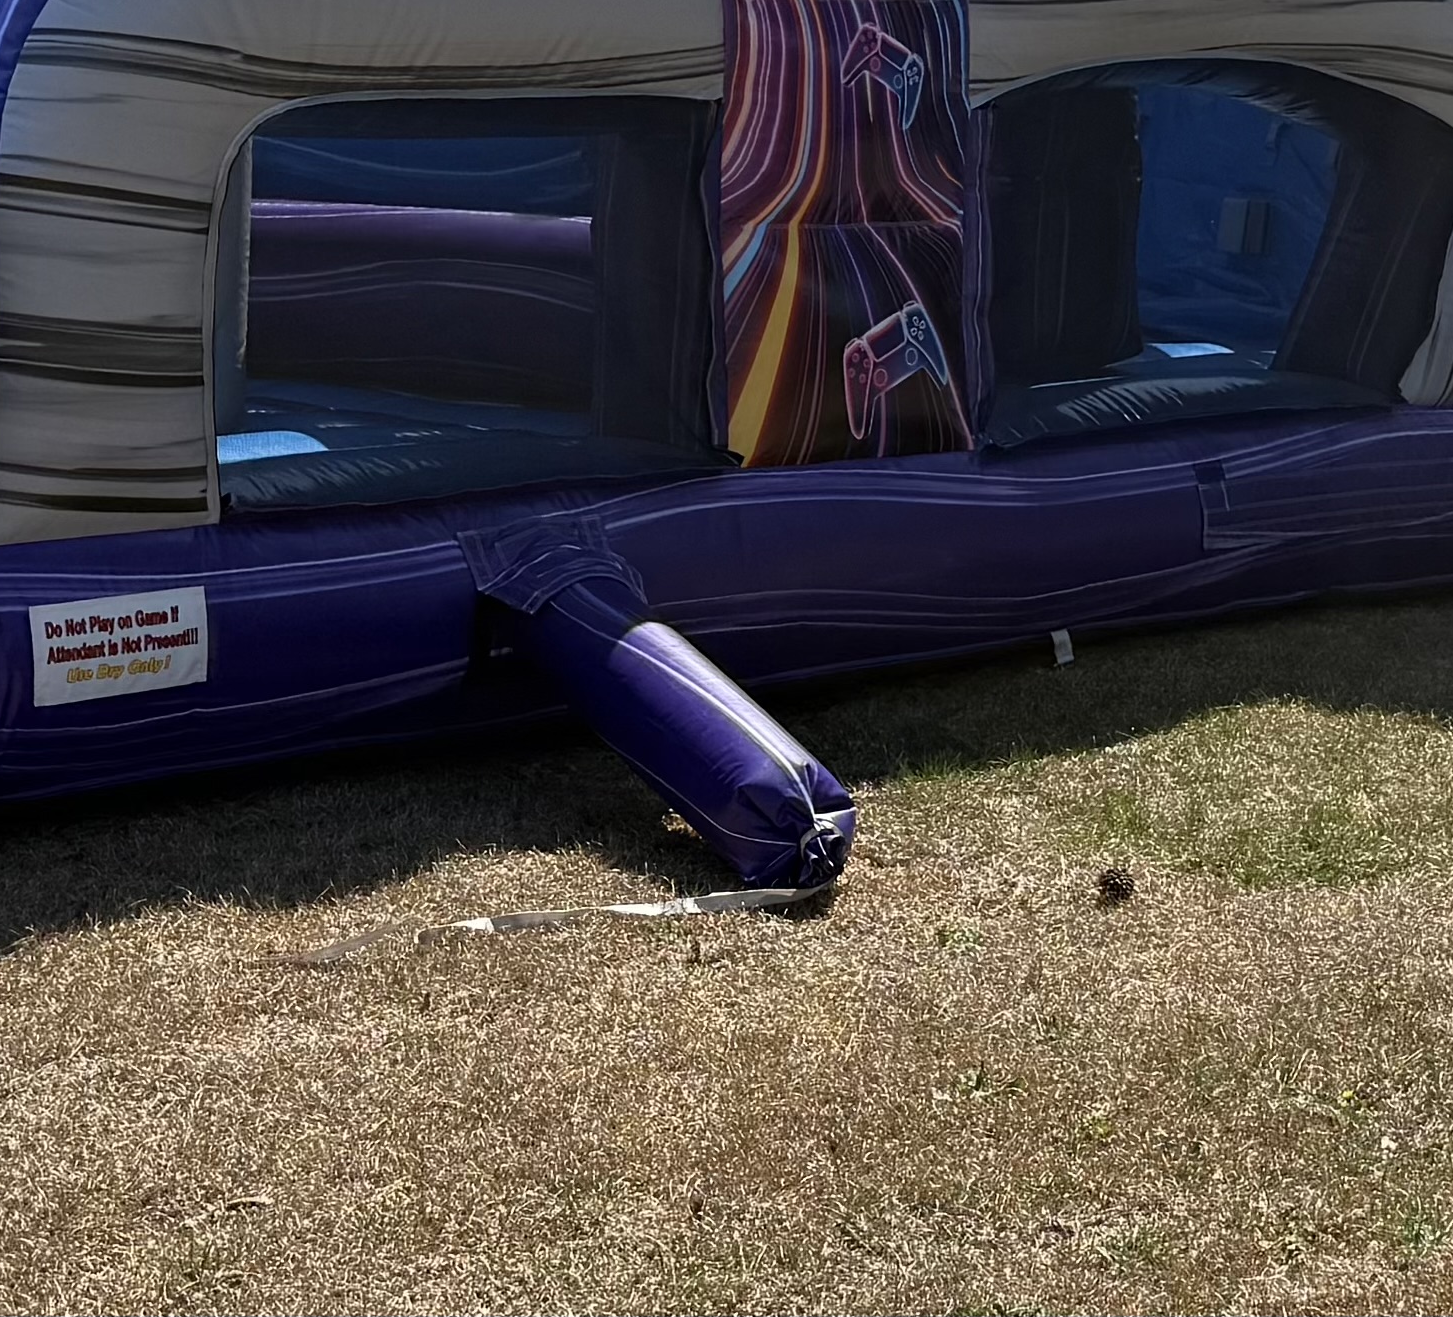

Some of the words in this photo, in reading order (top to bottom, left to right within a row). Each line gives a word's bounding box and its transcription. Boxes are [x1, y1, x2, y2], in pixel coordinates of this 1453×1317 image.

[44, 621, 63, 640] Do
[65, 618, 88, 637] Not
[89, 614, 115, 636] Play
[117, 614, 133, 630] on
[134, 609, 169, 628] Game
[47, 640, 106, 665] Attendant
[120, 634, 143, 655] Not
[66, 667, 94, 684] Use
[96, 663, 125, 680] Dry
